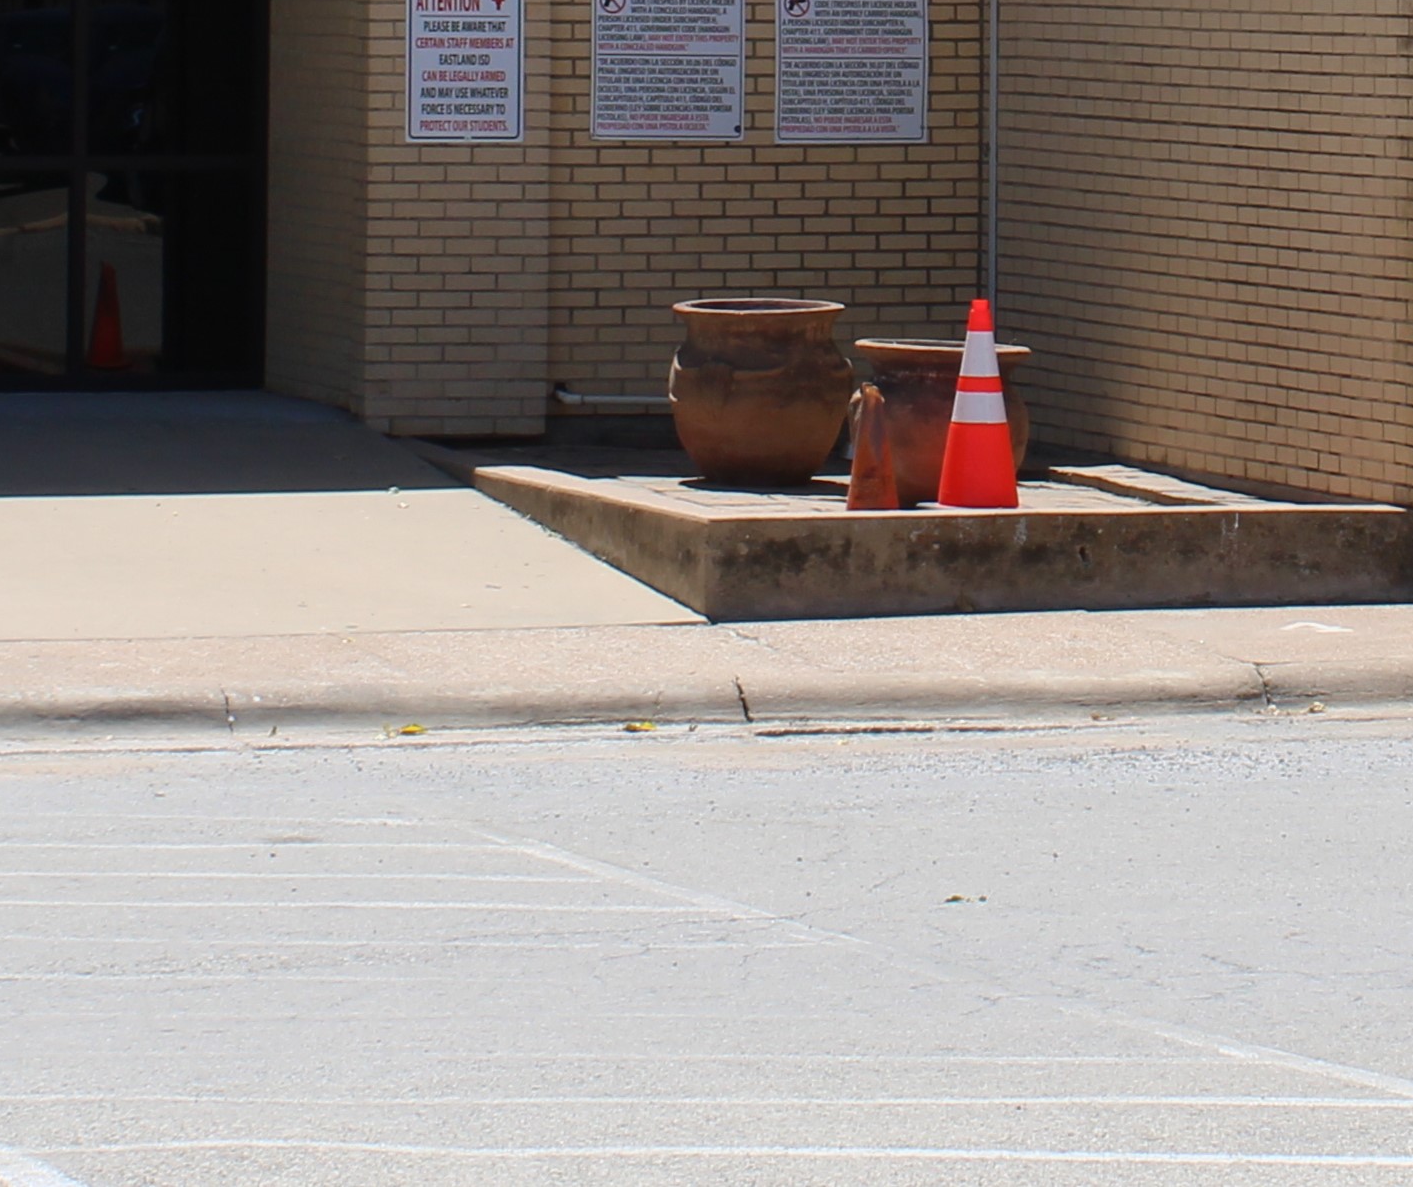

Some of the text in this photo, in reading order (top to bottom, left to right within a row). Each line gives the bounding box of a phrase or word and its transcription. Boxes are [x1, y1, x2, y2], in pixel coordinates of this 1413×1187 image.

[423, 21, 506, 32] PLEASE BE AWARE THAT
[415, 37, 445, 49] CERTAIN
[446, 37, 469, 49] STAFF
[505, 37, 514, 49] AT
[439, 54, 477, 66] EASTLAND
[422, 70, 438, 82] CAN
[439, 70, 448, 82] BE
[449, 70, 479, 82] LEGALLY
[420, 87, 509, 99] AND MAY USE WHATEVER
[421, 103, 505, 115] FORCE IS NECESSARY TO
[420, 120, 451, 132] PROTECT
[453, 120, 469, 132] OUR
